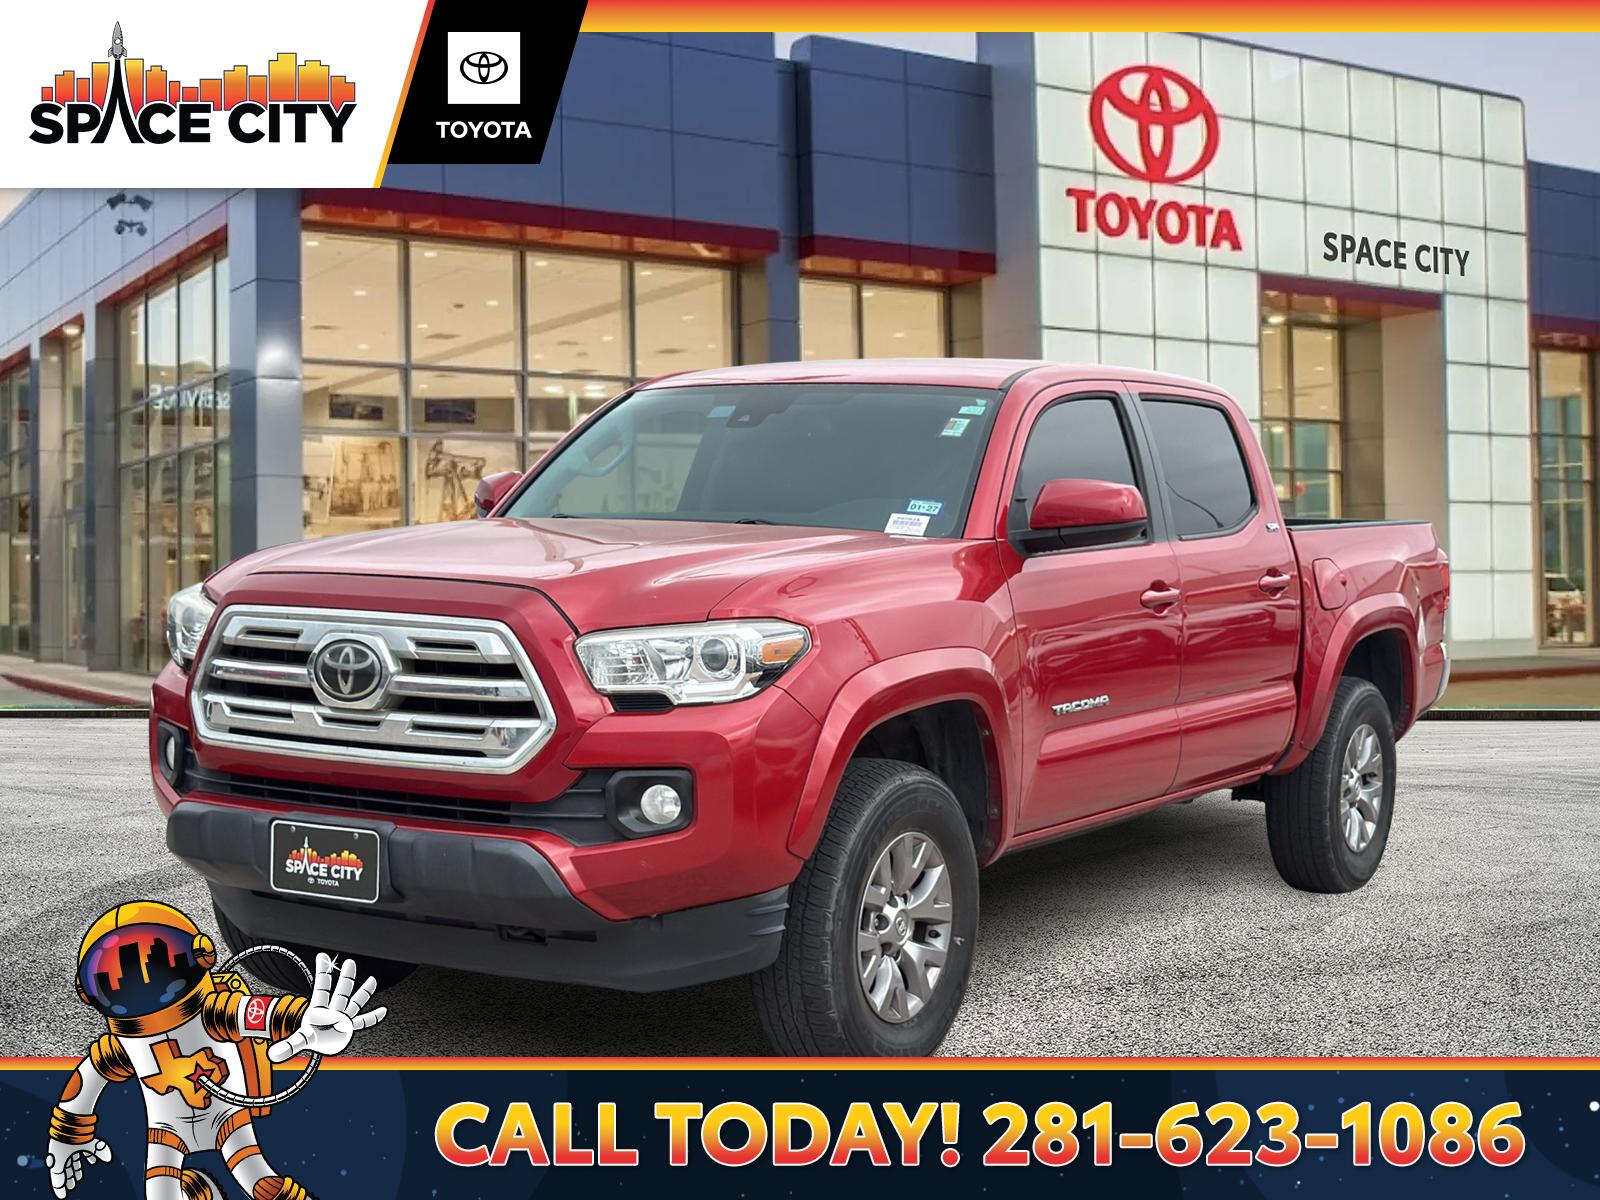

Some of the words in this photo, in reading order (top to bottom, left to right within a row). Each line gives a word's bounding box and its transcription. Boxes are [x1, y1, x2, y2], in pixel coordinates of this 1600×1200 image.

[1066, 187, 1242, 252] TOYOTA
[1323, 231, 1407, 270] SPACE
[1415, 244, 1470, 277] CITY
[1051, 694, 1110, 715] TACOMA
[285, 848, 329, 877] SPACE
[331, 865, 363, 881] CITY
[316, 878, 340, 887] TOYOTA
